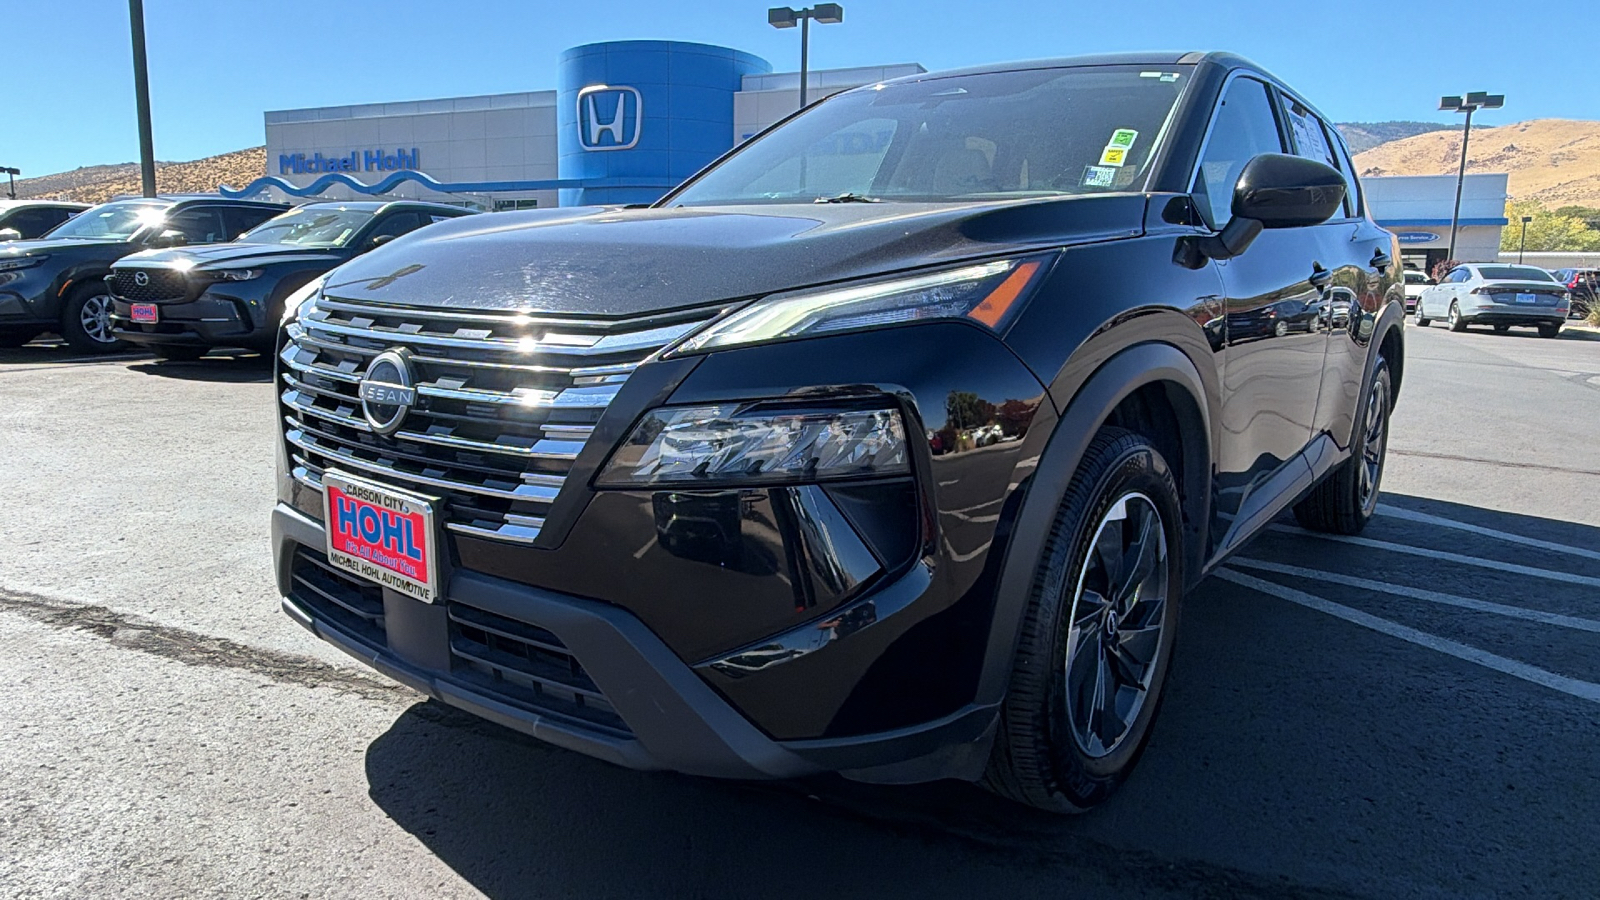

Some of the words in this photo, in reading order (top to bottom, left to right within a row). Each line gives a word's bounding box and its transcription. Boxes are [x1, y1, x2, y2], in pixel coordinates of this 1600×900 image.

[279, 151, 361, 175] Michael
[364, 148, 420, 171] Hohl
[346, 484, 382, 504] CARSON
[383, 496, 405, 512] CITY
[337, 497, 422, 561] HOHL
[346, 540, 358, 555] It's
[360, 544, 371, 559] All
[372, 549, 398, 570] About
[330, 551, 361, 573] MICHAEL
[361, 563, 381, 581] HOHL
[381, 572, 431, 600] AUTOMOTIVE
